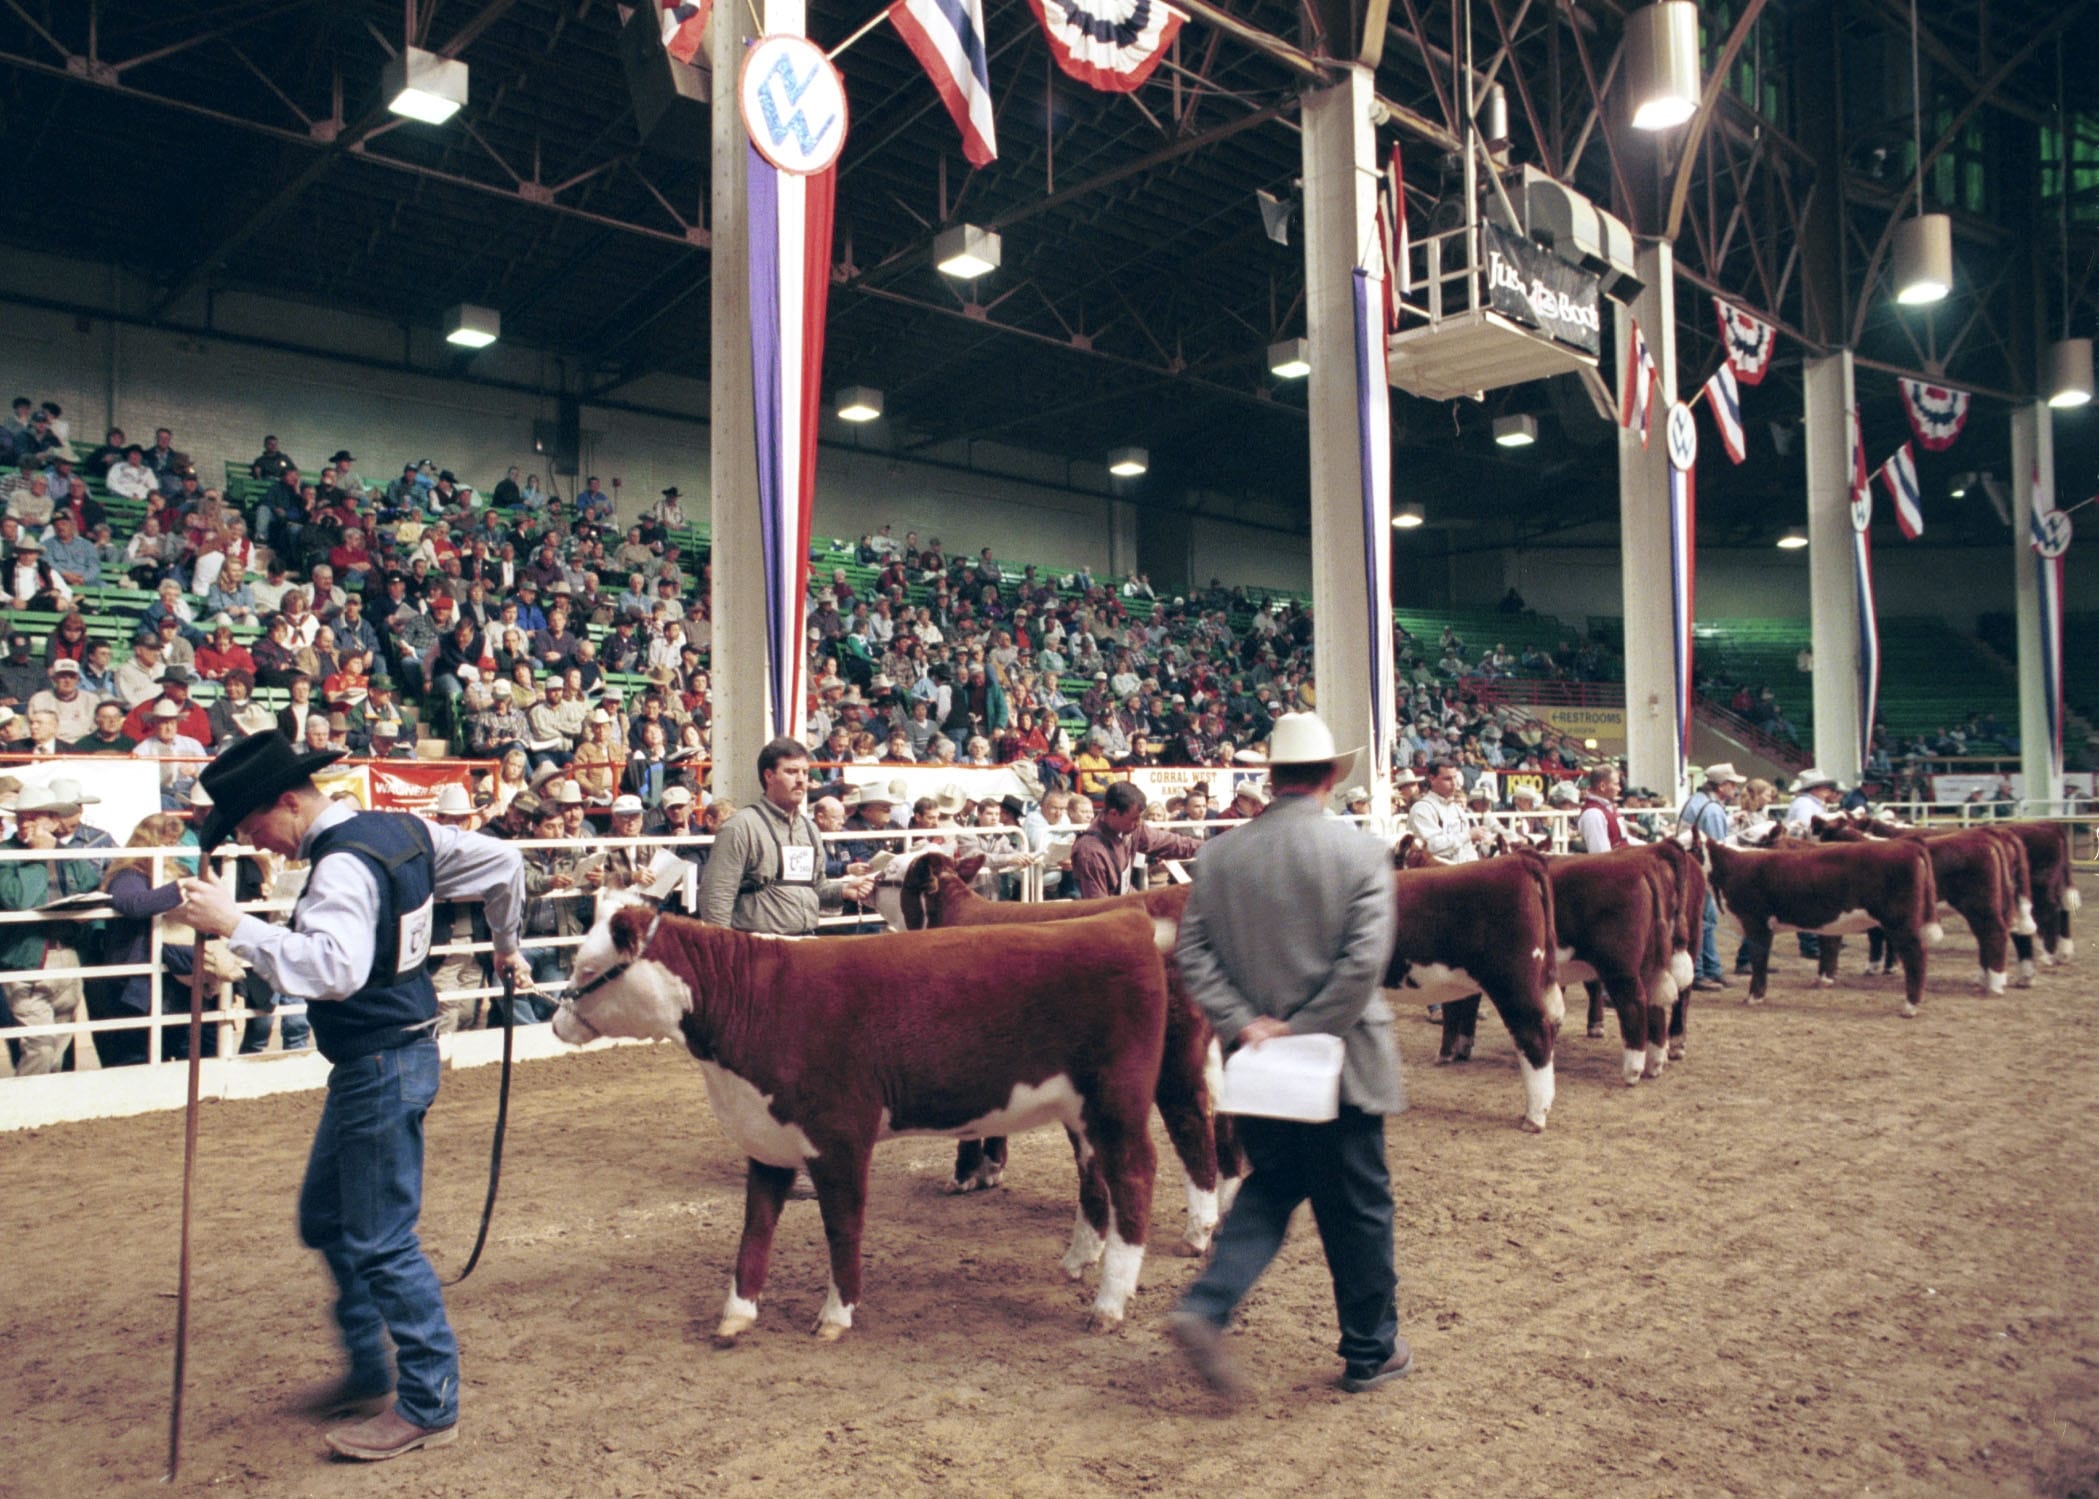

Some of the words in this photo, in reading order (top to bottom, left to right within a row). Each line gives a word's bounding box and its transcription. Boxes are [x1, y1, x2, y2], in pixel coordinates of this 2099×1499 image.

[1559, 711, 1622, 725] RESTROOMS
[1150, 771, 1188, 784] CORRAL
[1191, 771, 1217, 784] WEST
